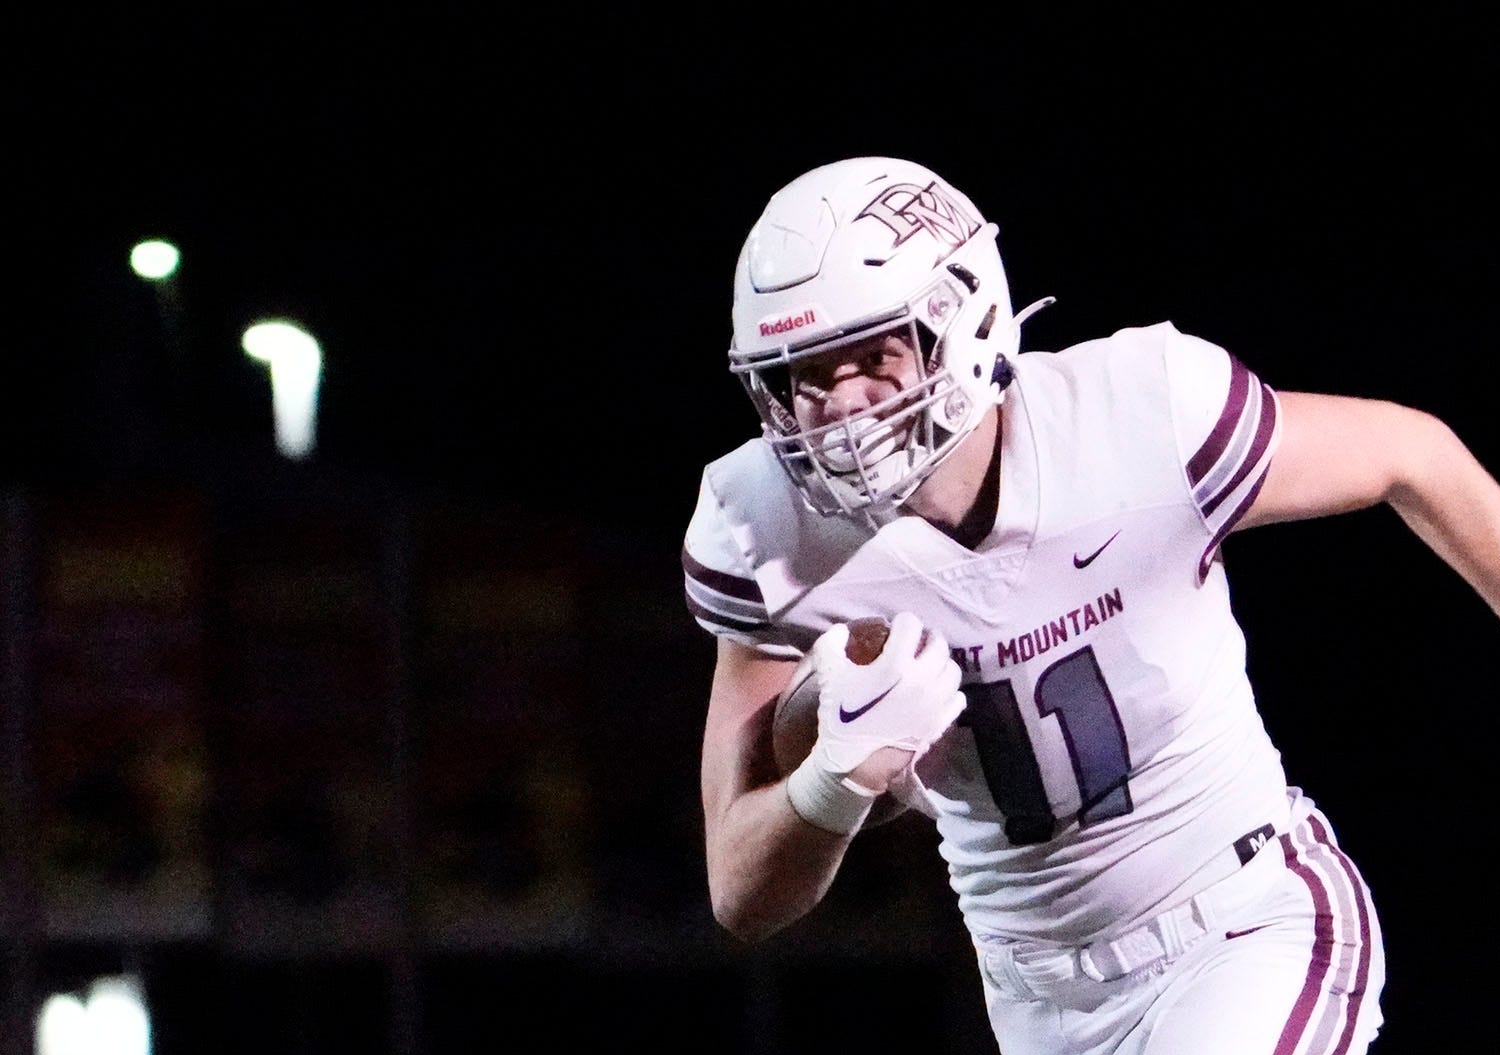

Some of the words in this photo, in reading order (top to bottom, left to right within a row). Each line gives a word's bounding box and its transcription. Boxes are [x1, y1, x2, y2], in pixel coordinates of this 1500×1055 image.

[759, 309, 817, 337] Riddell
[997, 586, 1125, 669] MOUNTAIN
[957, 643, 1135, 846] 11
